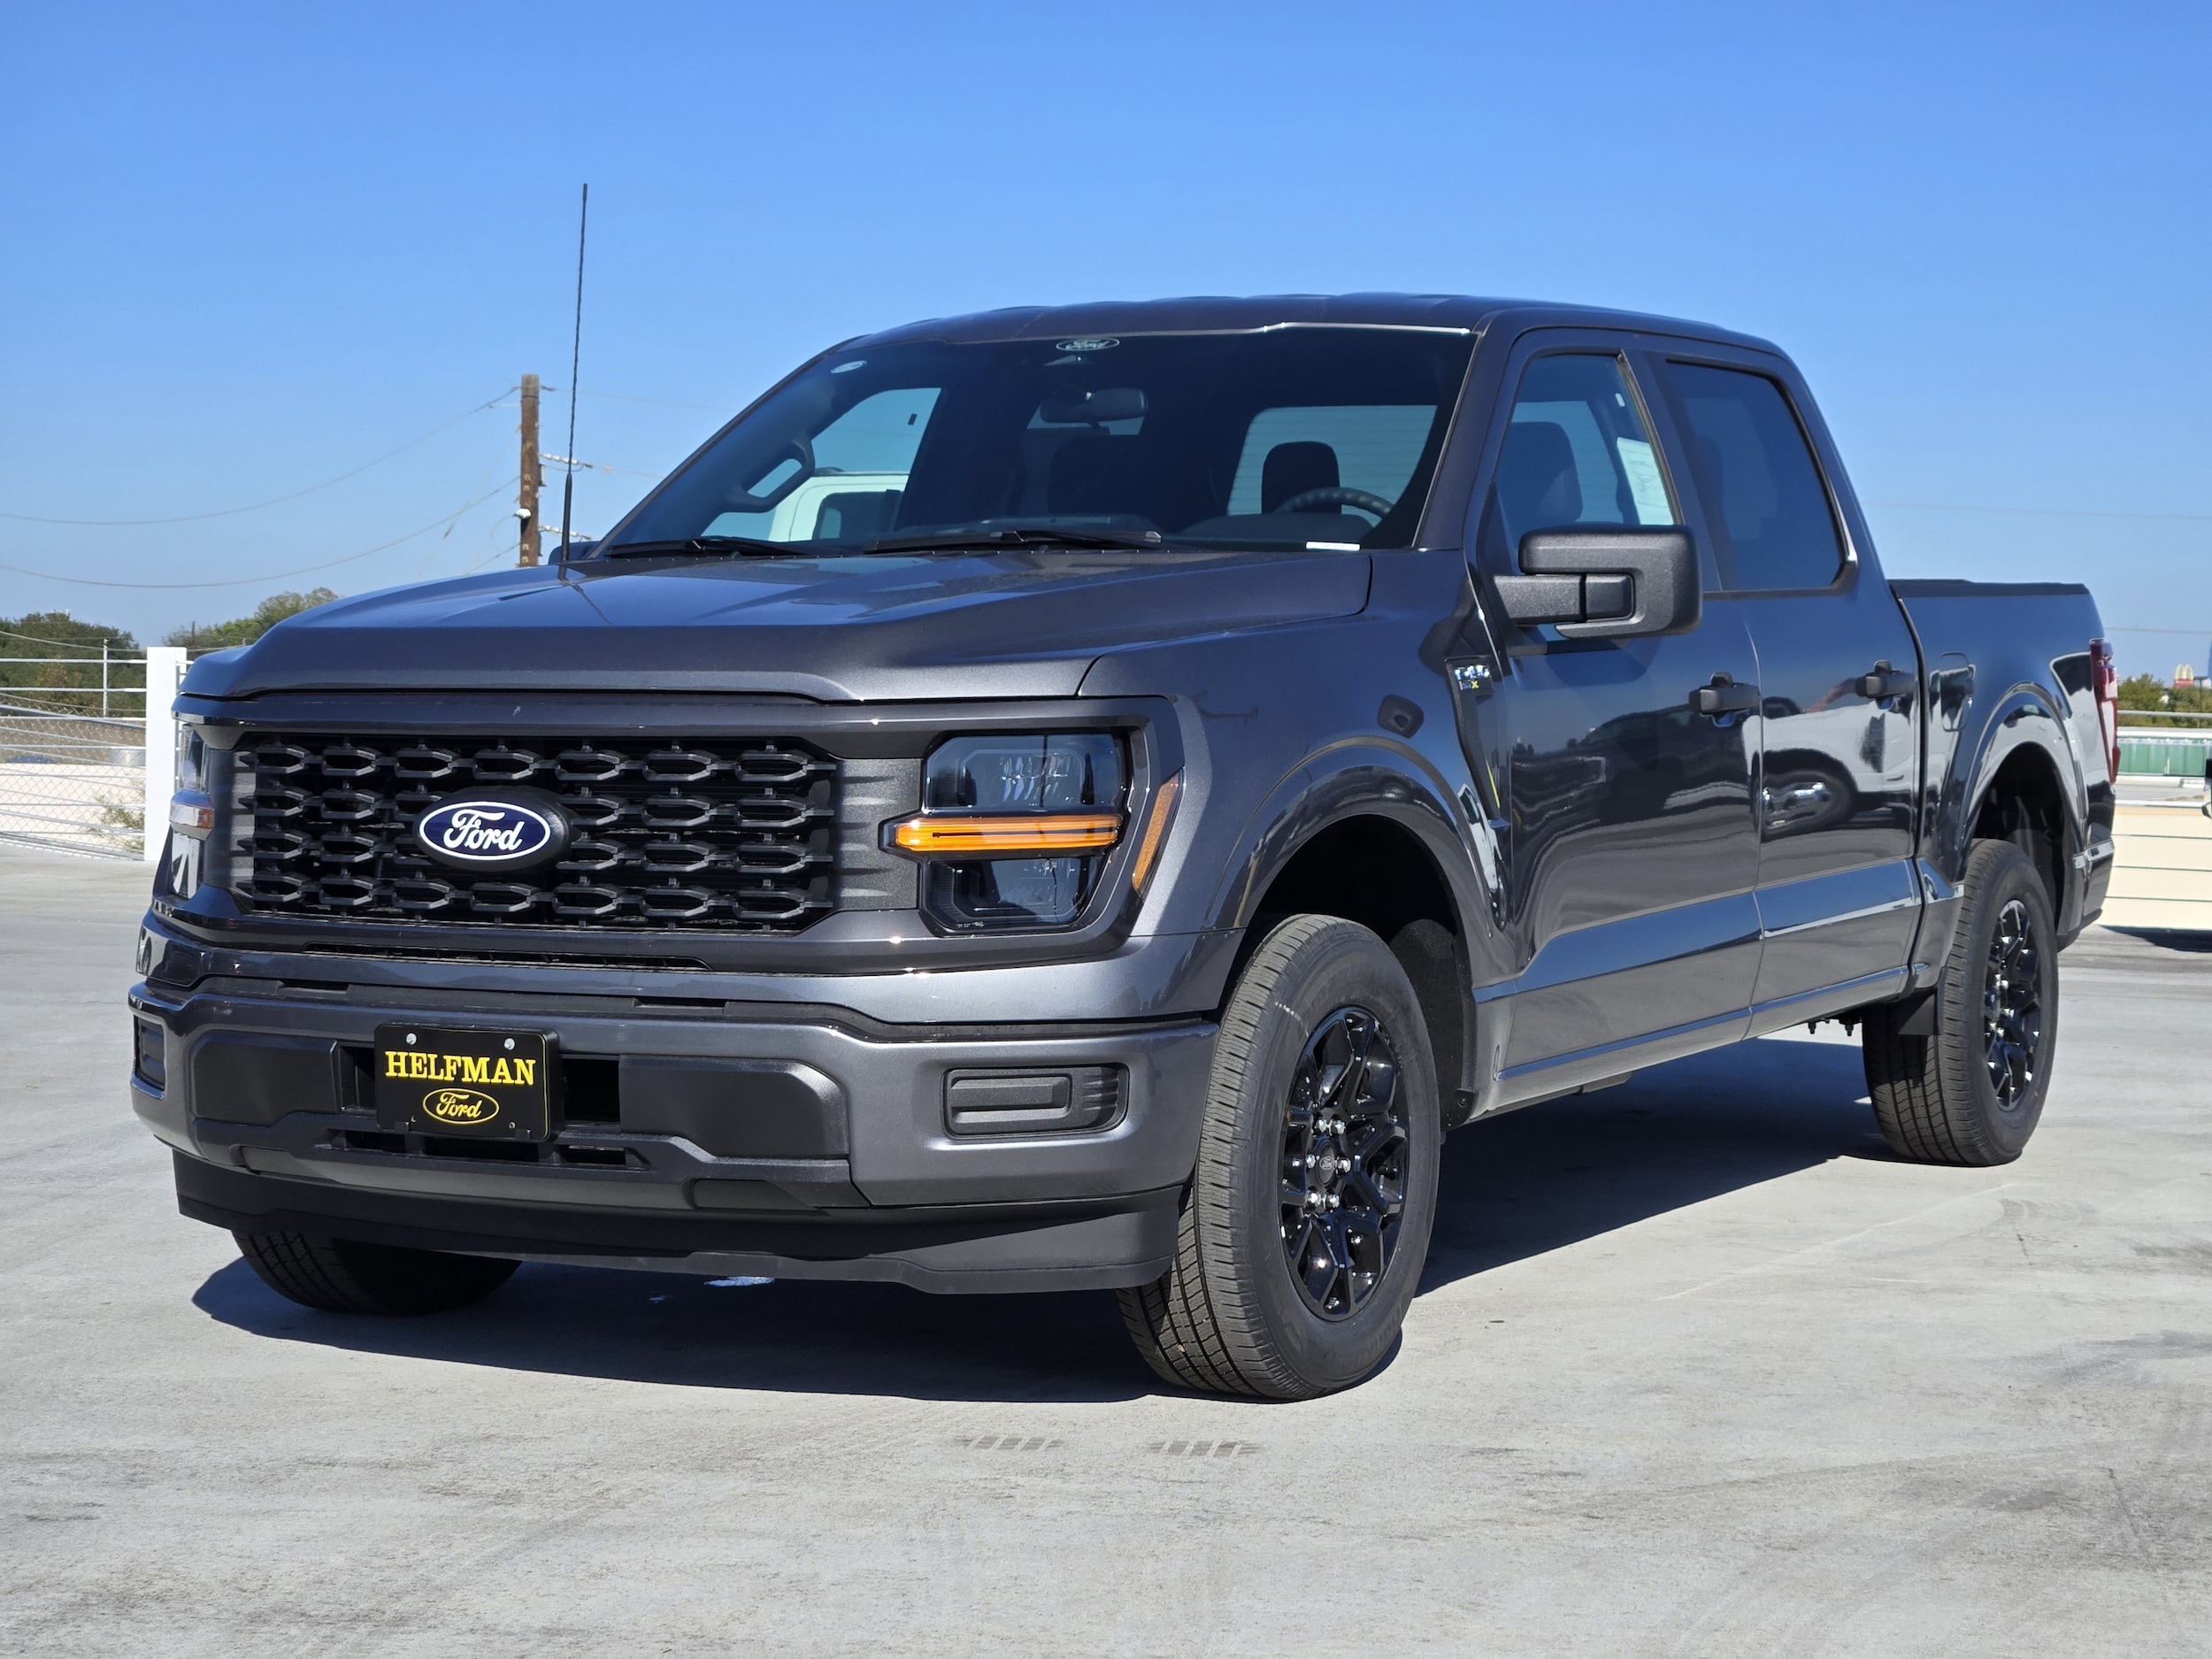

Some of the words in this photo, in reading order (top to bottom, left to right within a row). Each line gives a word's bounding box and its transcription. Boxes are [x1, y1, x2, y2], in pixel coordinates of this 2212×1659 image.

[443, 809, 525, 851] Ford
[384, 1050, 536, 1086] HELFMAN
[435, 1092, 483, 1118] Ford
